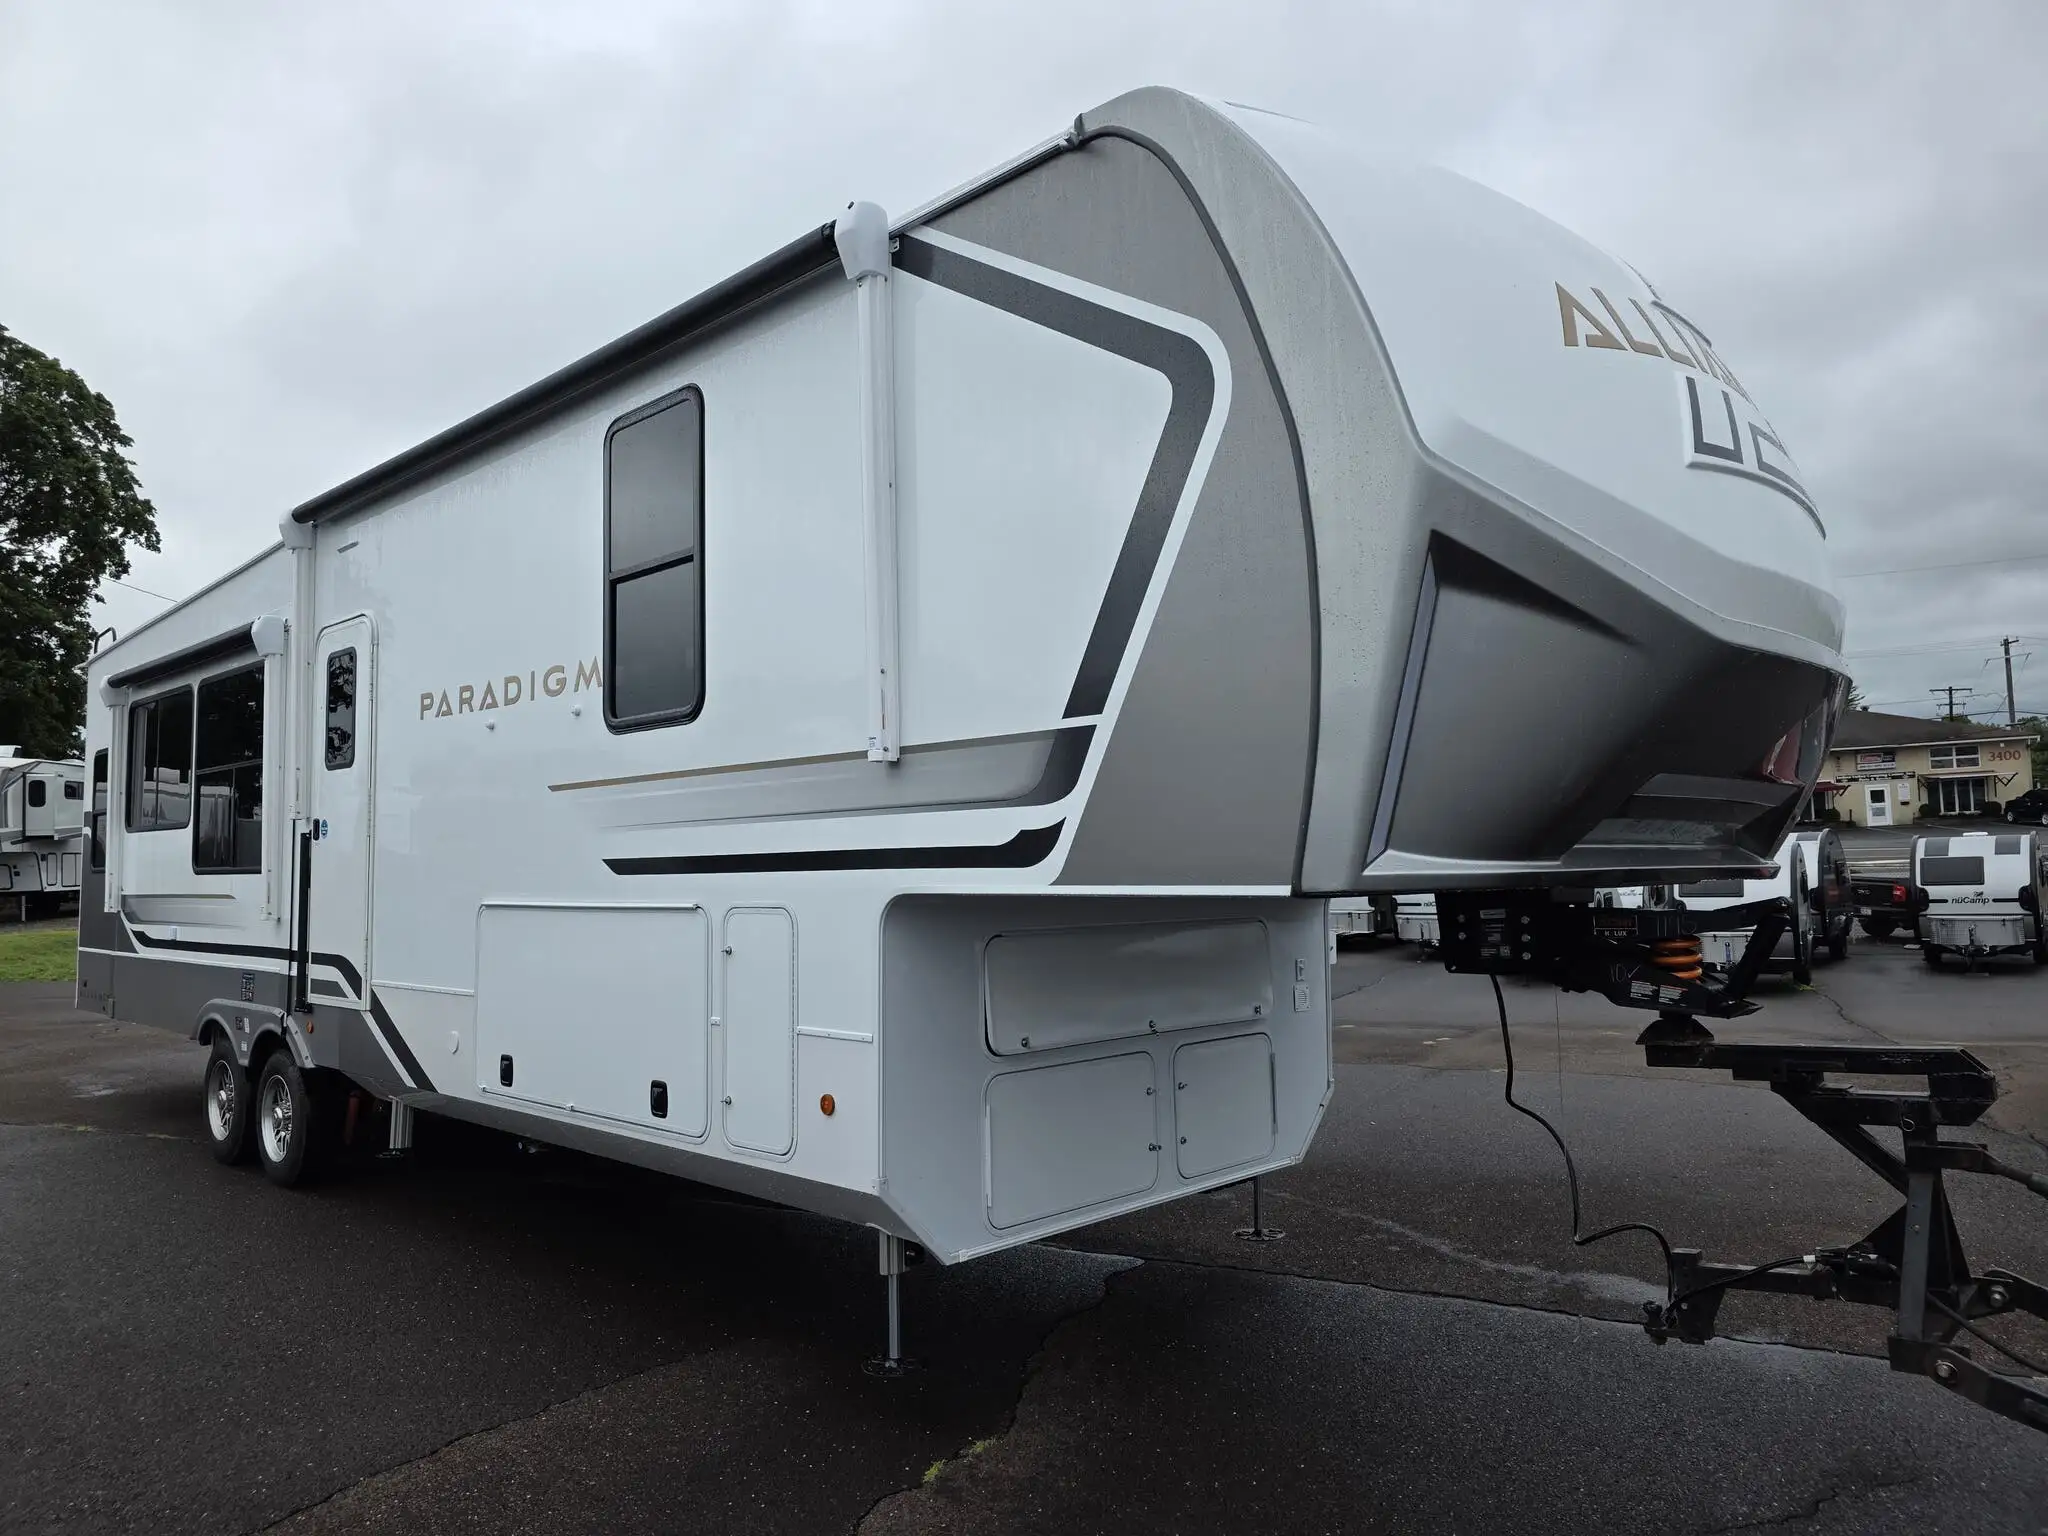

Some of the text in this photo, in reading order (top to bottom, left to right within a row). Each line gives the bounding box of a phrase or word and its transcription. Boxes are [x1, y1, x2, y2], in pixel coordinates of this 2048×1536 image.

[420, 655, 603, 721] PARADIGM
[1988, 750, 2021, 761] 3400
[1951, 895, 1990, 906] nüCamp
